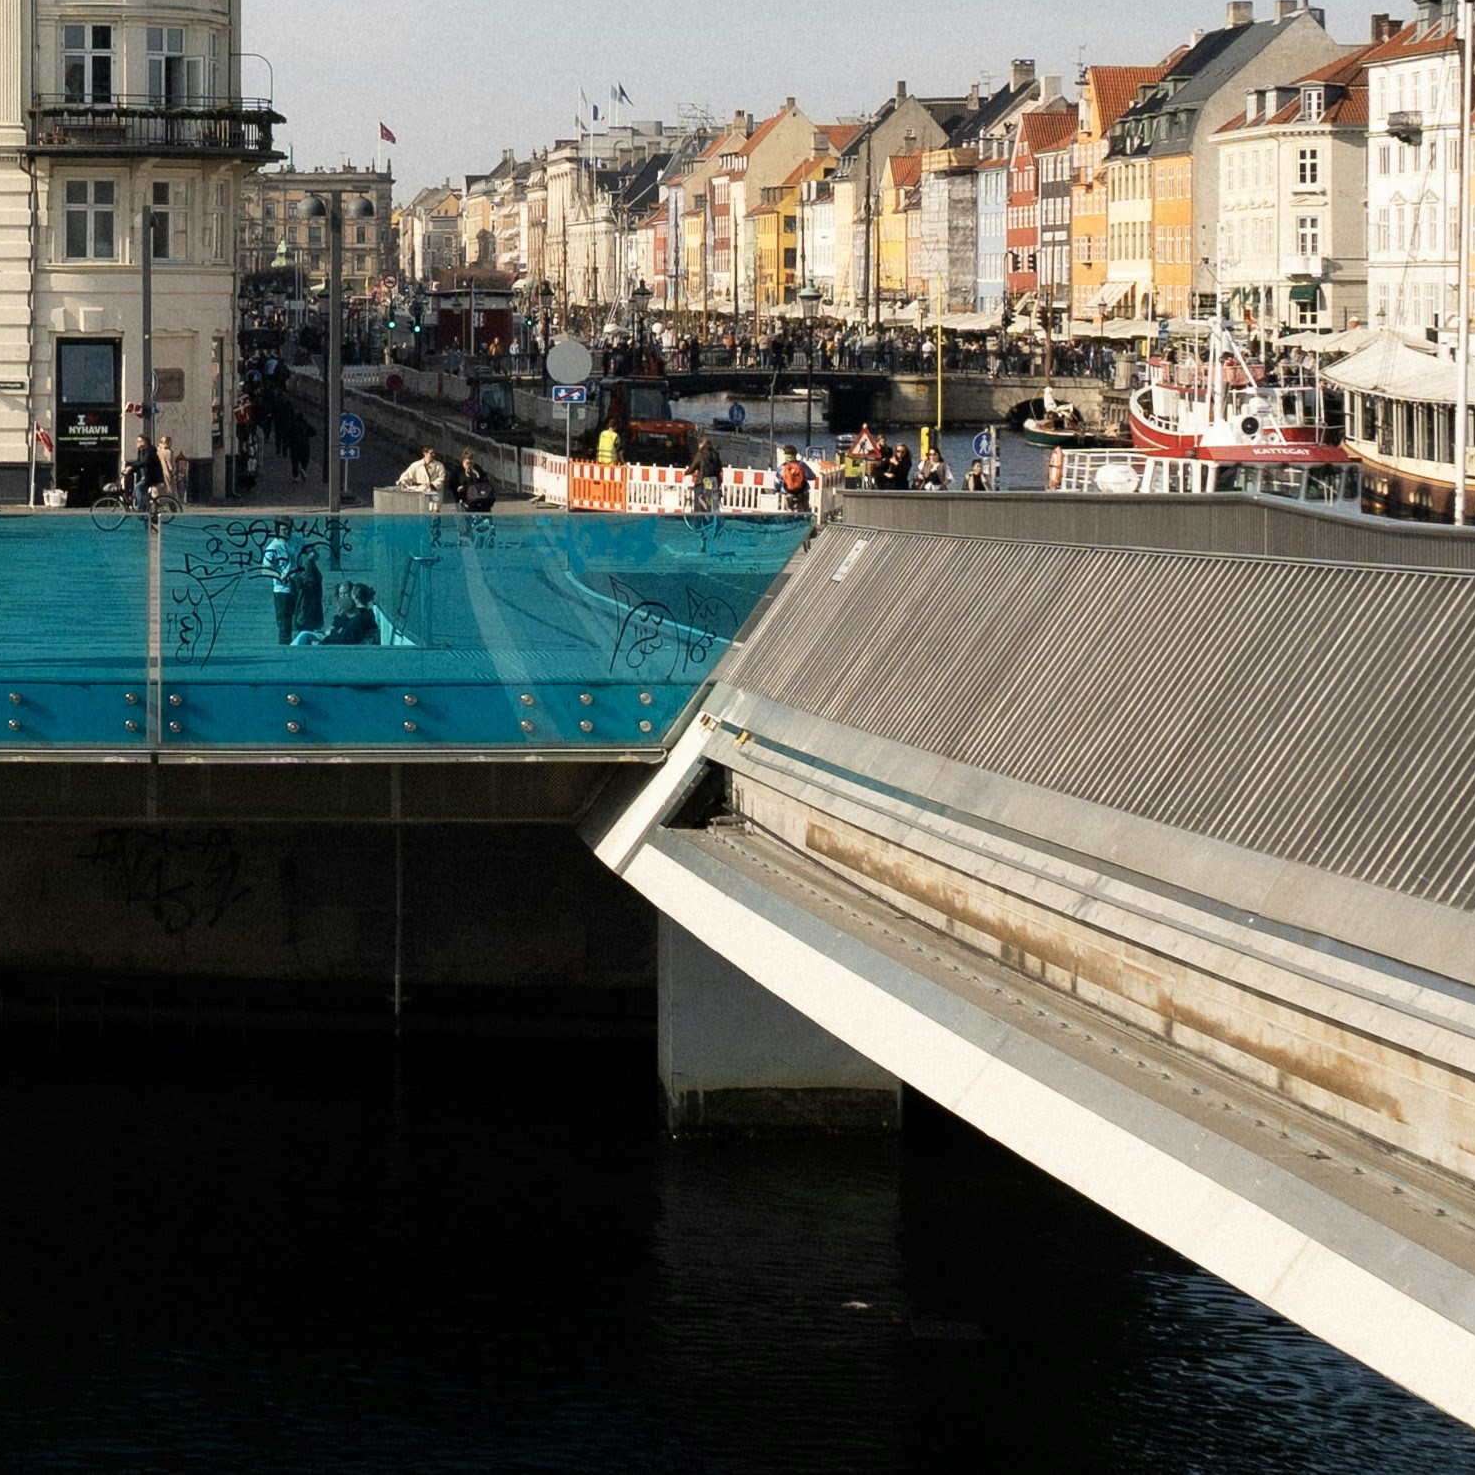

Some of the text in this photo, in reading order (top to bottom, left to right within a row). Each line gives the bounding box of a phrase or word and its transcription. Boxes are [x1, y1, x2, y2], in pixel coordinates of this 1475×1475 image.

[78, 415, 85, 425] I
[68, 425, 109, 434] NYHAVN
[1252, 447, 1311, 456] KATTEGAT
